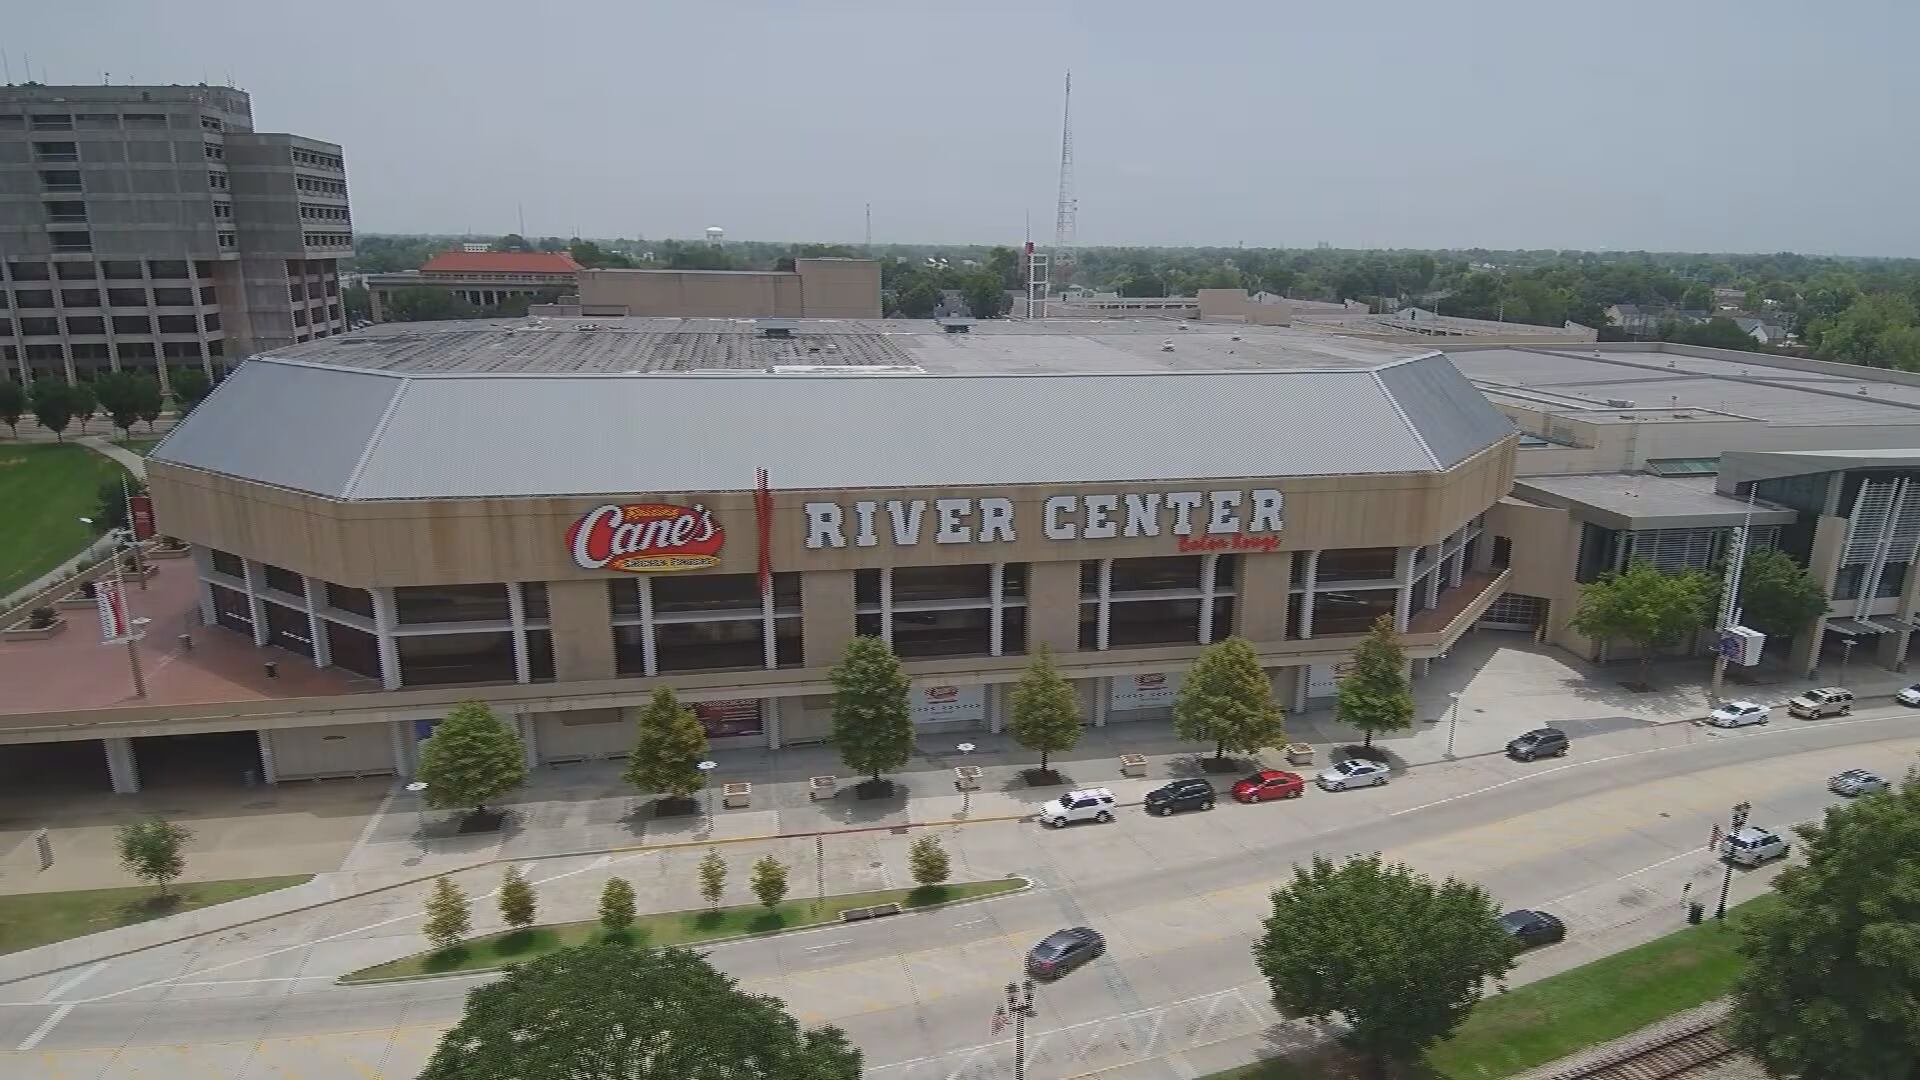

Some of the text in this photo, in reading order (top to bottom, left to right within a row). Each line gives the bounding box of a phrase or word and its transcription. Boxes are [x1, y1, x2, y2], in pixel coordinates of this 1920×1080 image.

[623, 506, 680, 520] Raising
[804, 489, 1284, 549] RIVER CENTER
[573, 503, 722, 569] Cane's
[1177, 531, 1282, 553] Baton Rouge
[623, 558, 667, 569] CHICKEN
